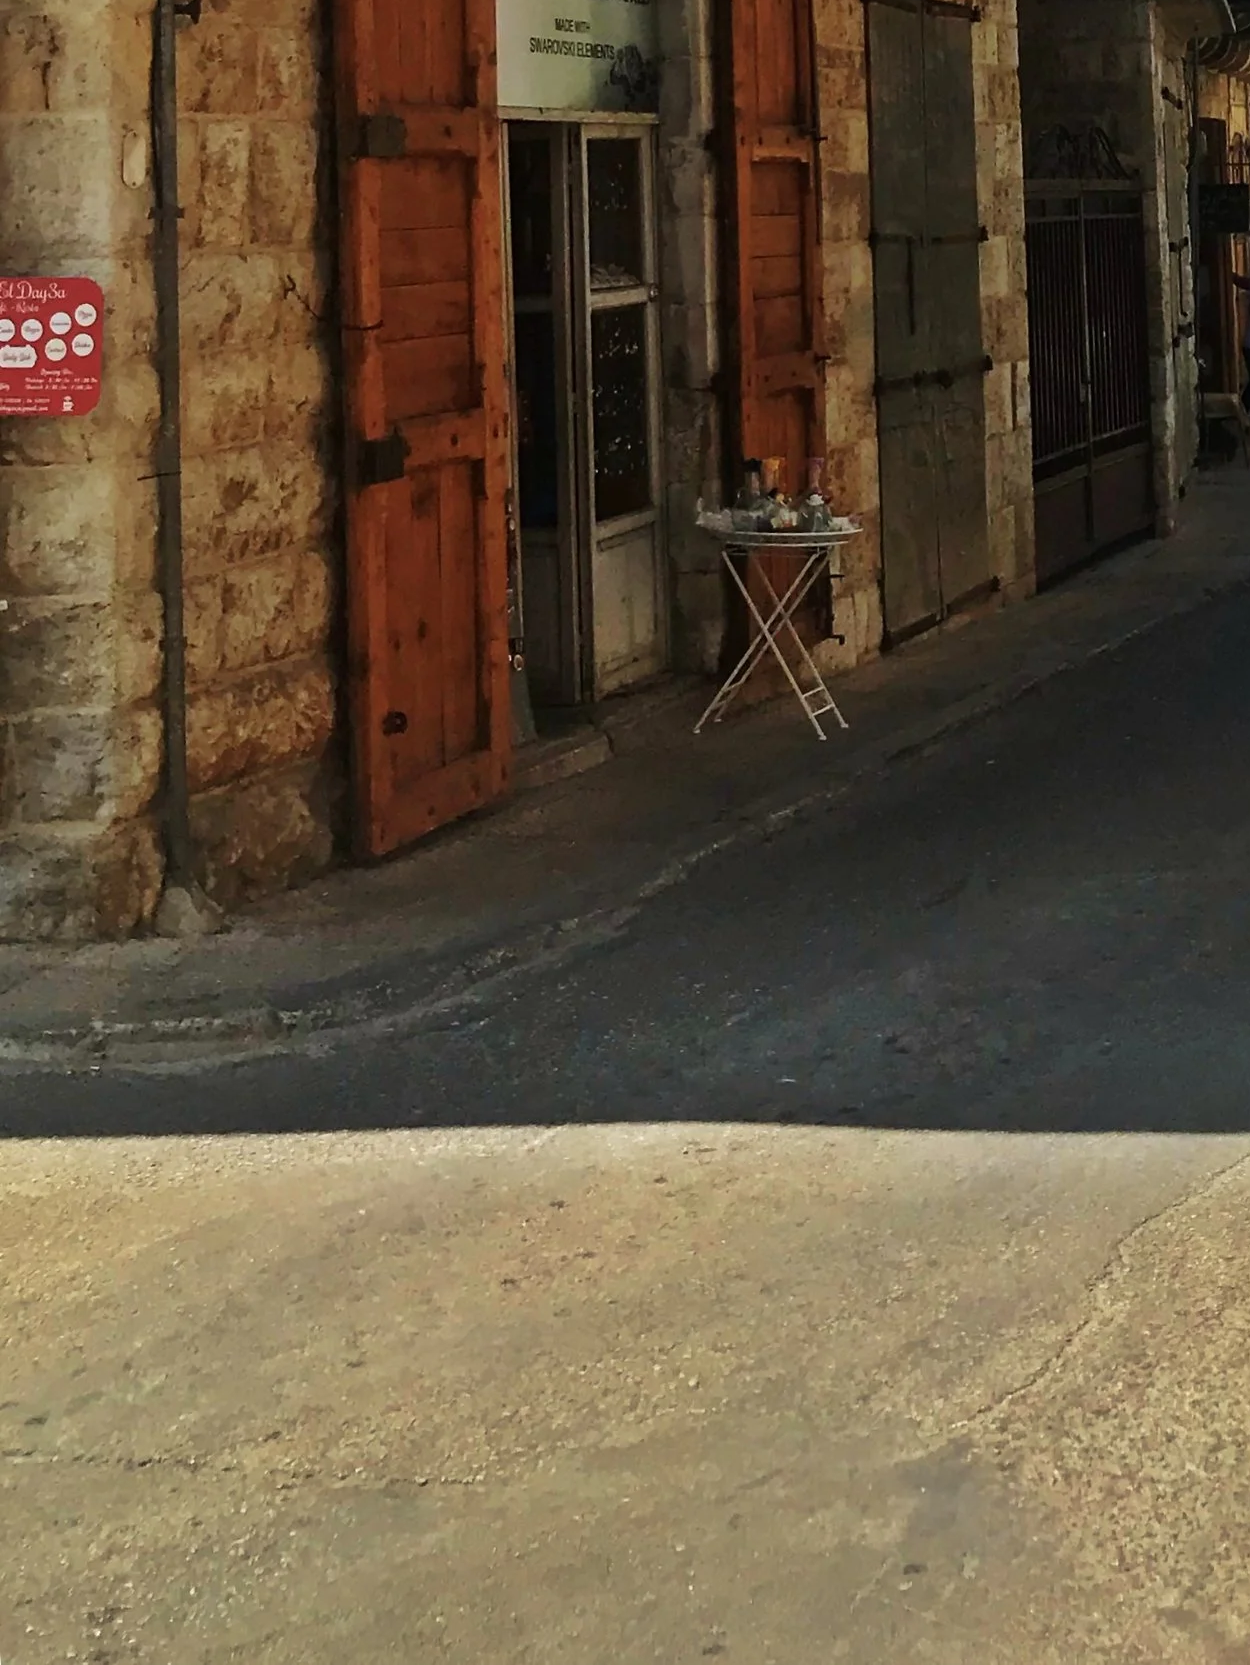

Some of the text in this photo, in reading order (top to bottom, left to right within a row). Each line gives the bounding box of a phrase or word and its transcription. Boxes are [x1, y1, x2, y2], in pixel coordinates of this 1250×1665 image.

[555, 17, 573, 32] MADE
[529, 37, 615, 60] SWAROVSKI ELEMENTS
